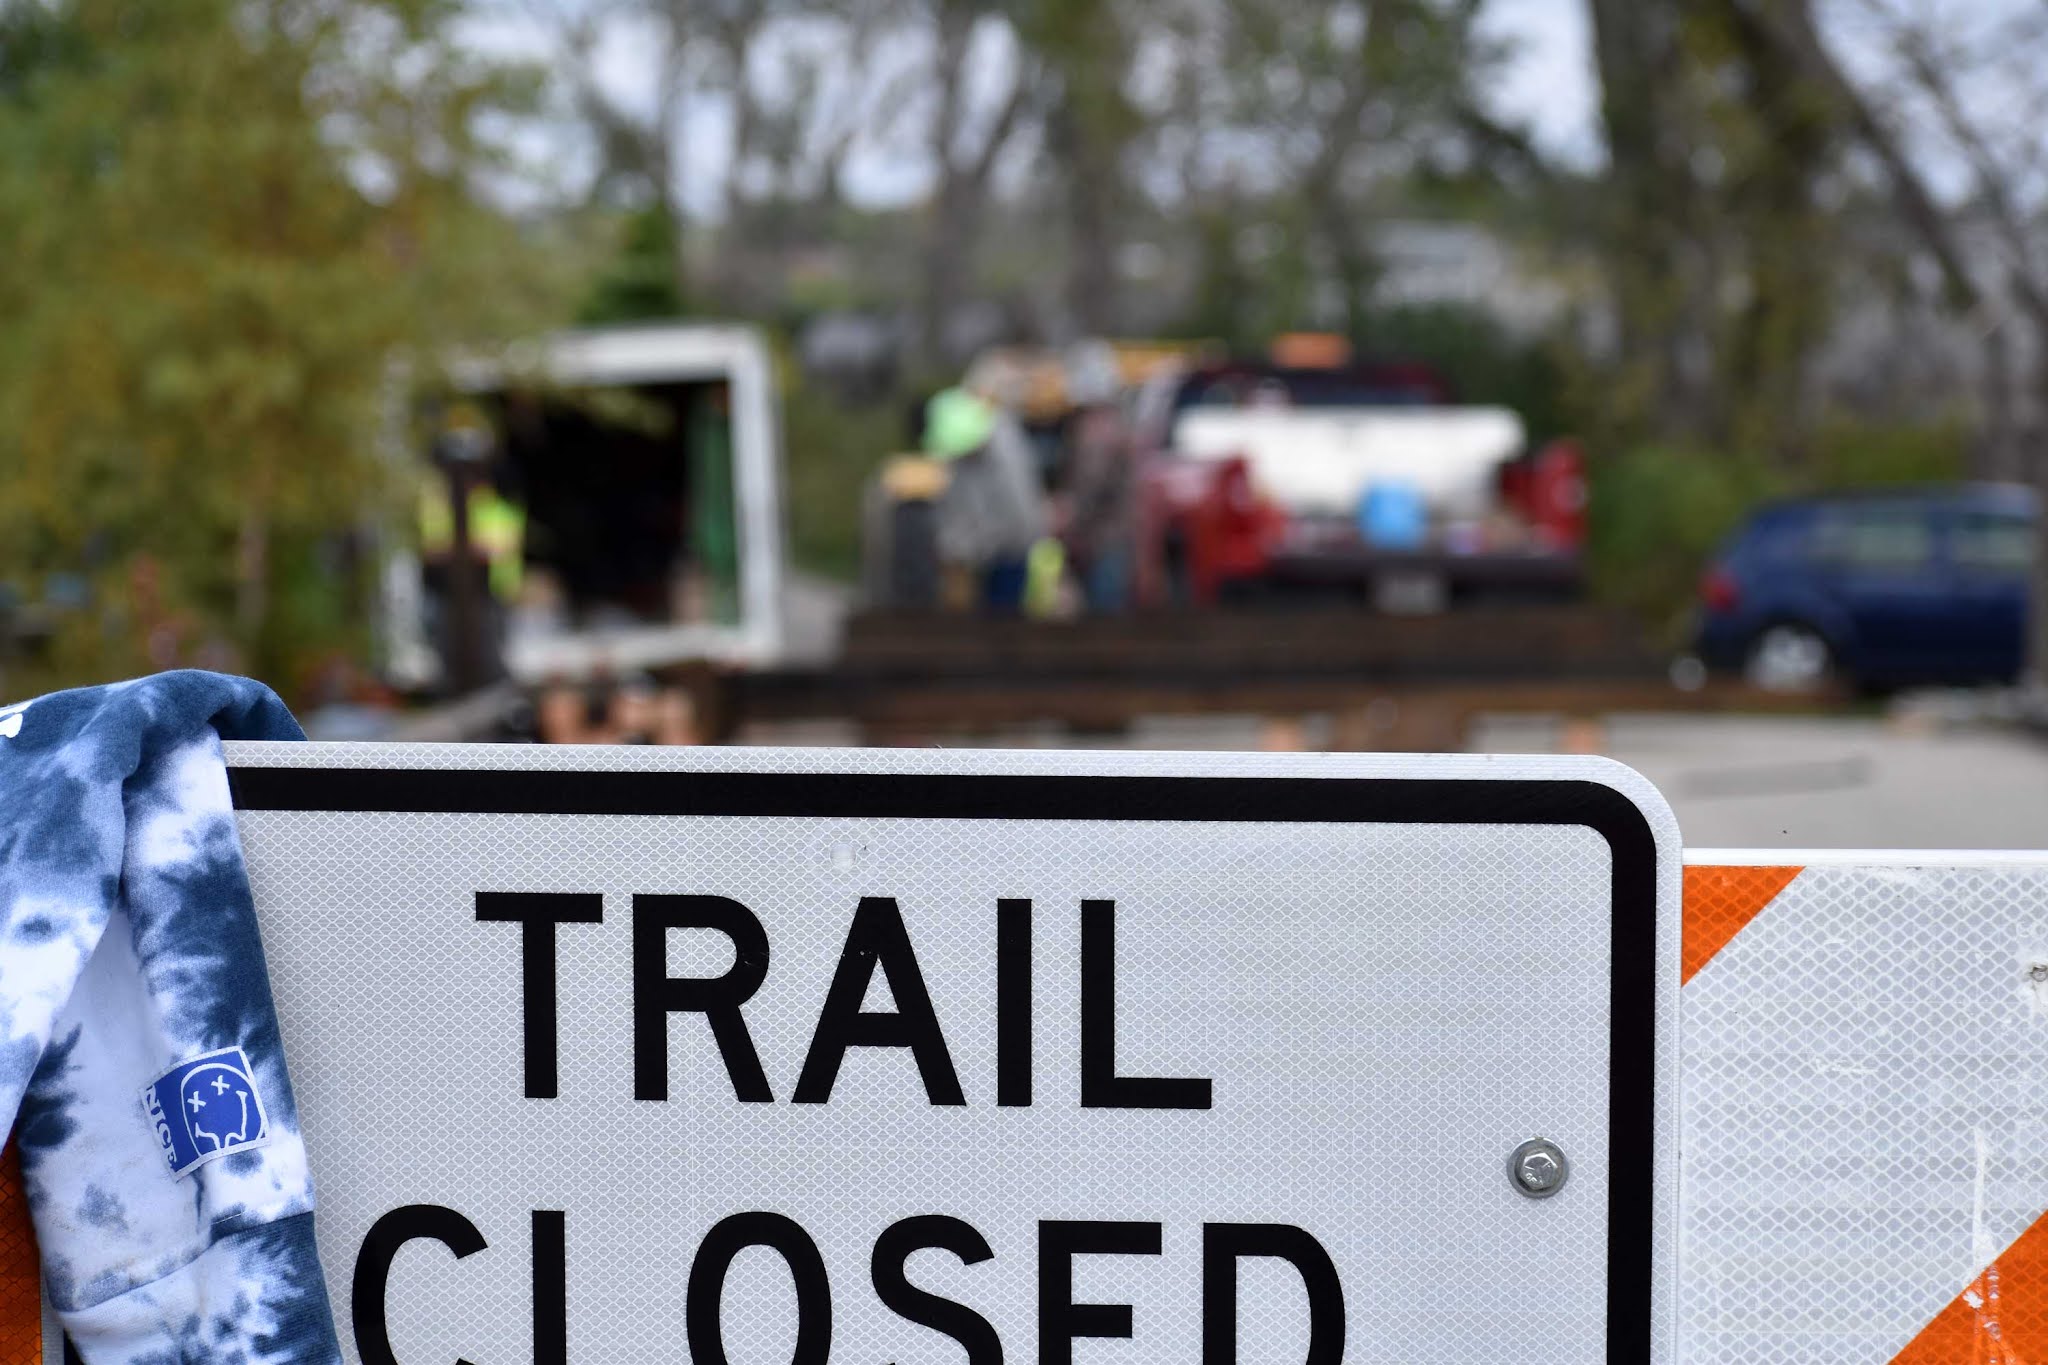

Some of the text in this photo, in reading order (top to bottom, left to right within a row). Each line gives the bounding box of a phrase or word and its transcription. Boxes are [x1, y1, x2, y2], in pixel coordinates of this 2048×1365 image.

[475, 891, 1213, 1110] TRAIL
[143, 1083, 178, 1166] NICE
[351, 1203, 1346, 1365] CLOSED
